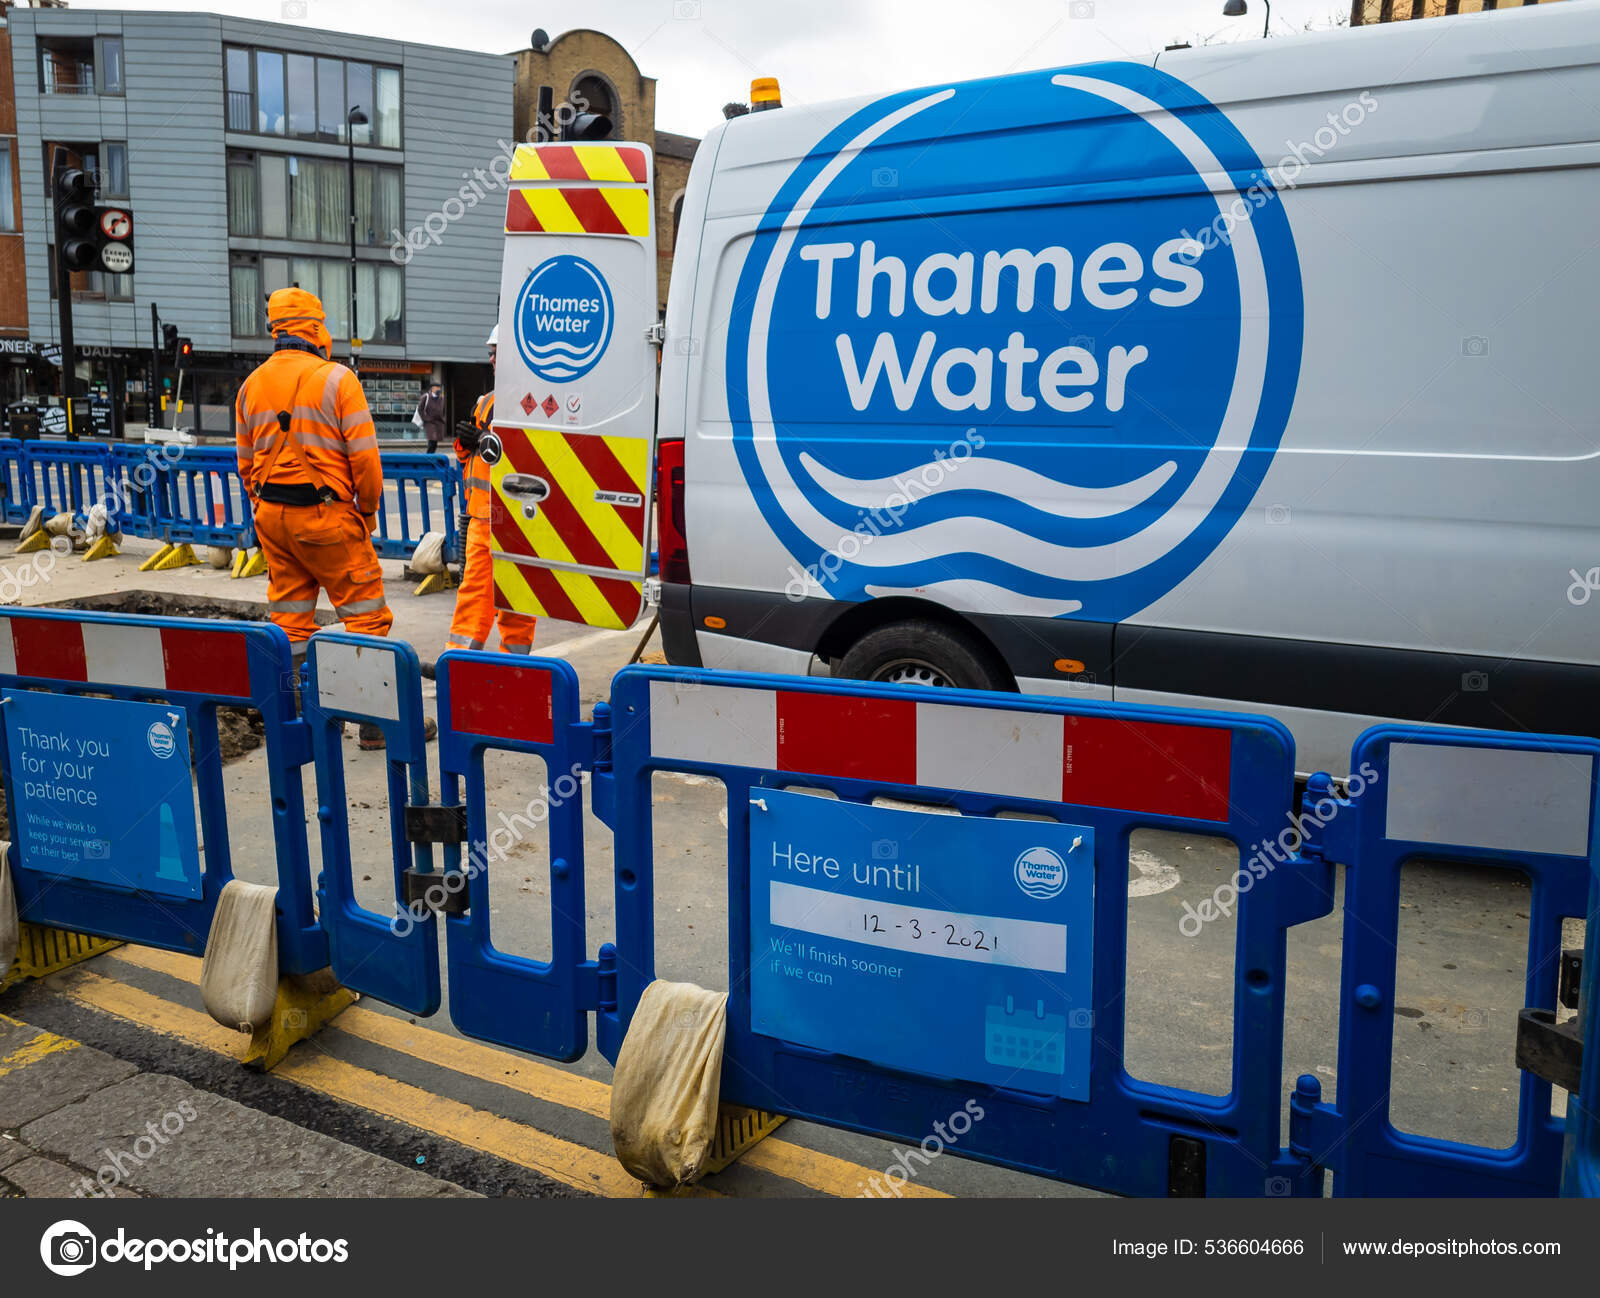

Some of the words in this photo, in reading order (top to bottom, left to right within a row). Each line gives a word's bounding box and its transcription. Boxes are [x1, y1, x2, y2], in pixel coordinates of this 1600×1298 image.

[104, 248, 131, 258] Except
[800, 238, 1205, 320] Thames
[529, 294, 600, 313] Thames
[536, 314, 590, 333] Water
[836, 330, 1149, 413] Water
[18, 727, 71, 753] Thank
[77, 740, 110, 758] you
[21, 752, 46, 774] for
[53, 761, 94, 780] your
[24, 780, 98, 806] patience
[26, 812, 50, 827] While
[52, 819, 64, 829] we
[65, 821, 86, 832] work
[87, 824, 97, 834] to
[28, 828, 47, 843] keep
[49, 833, 67, 845] your
[30, 846, 39, 855] at
[41, 845, 59, 857] their
[772, 841, 839, 879] Here
[853, 862, 920, 893] until
[1022, 861, 1061, 872] Thames
[1026, 870, 1056, 880] Water
[770, 937, 805, 960] We'll
[810, 946, 847, 968] finish
[851, 959, 903, 978] sooner
[784, 965, 803, 979] we
[808, 970, 832, 985] can
